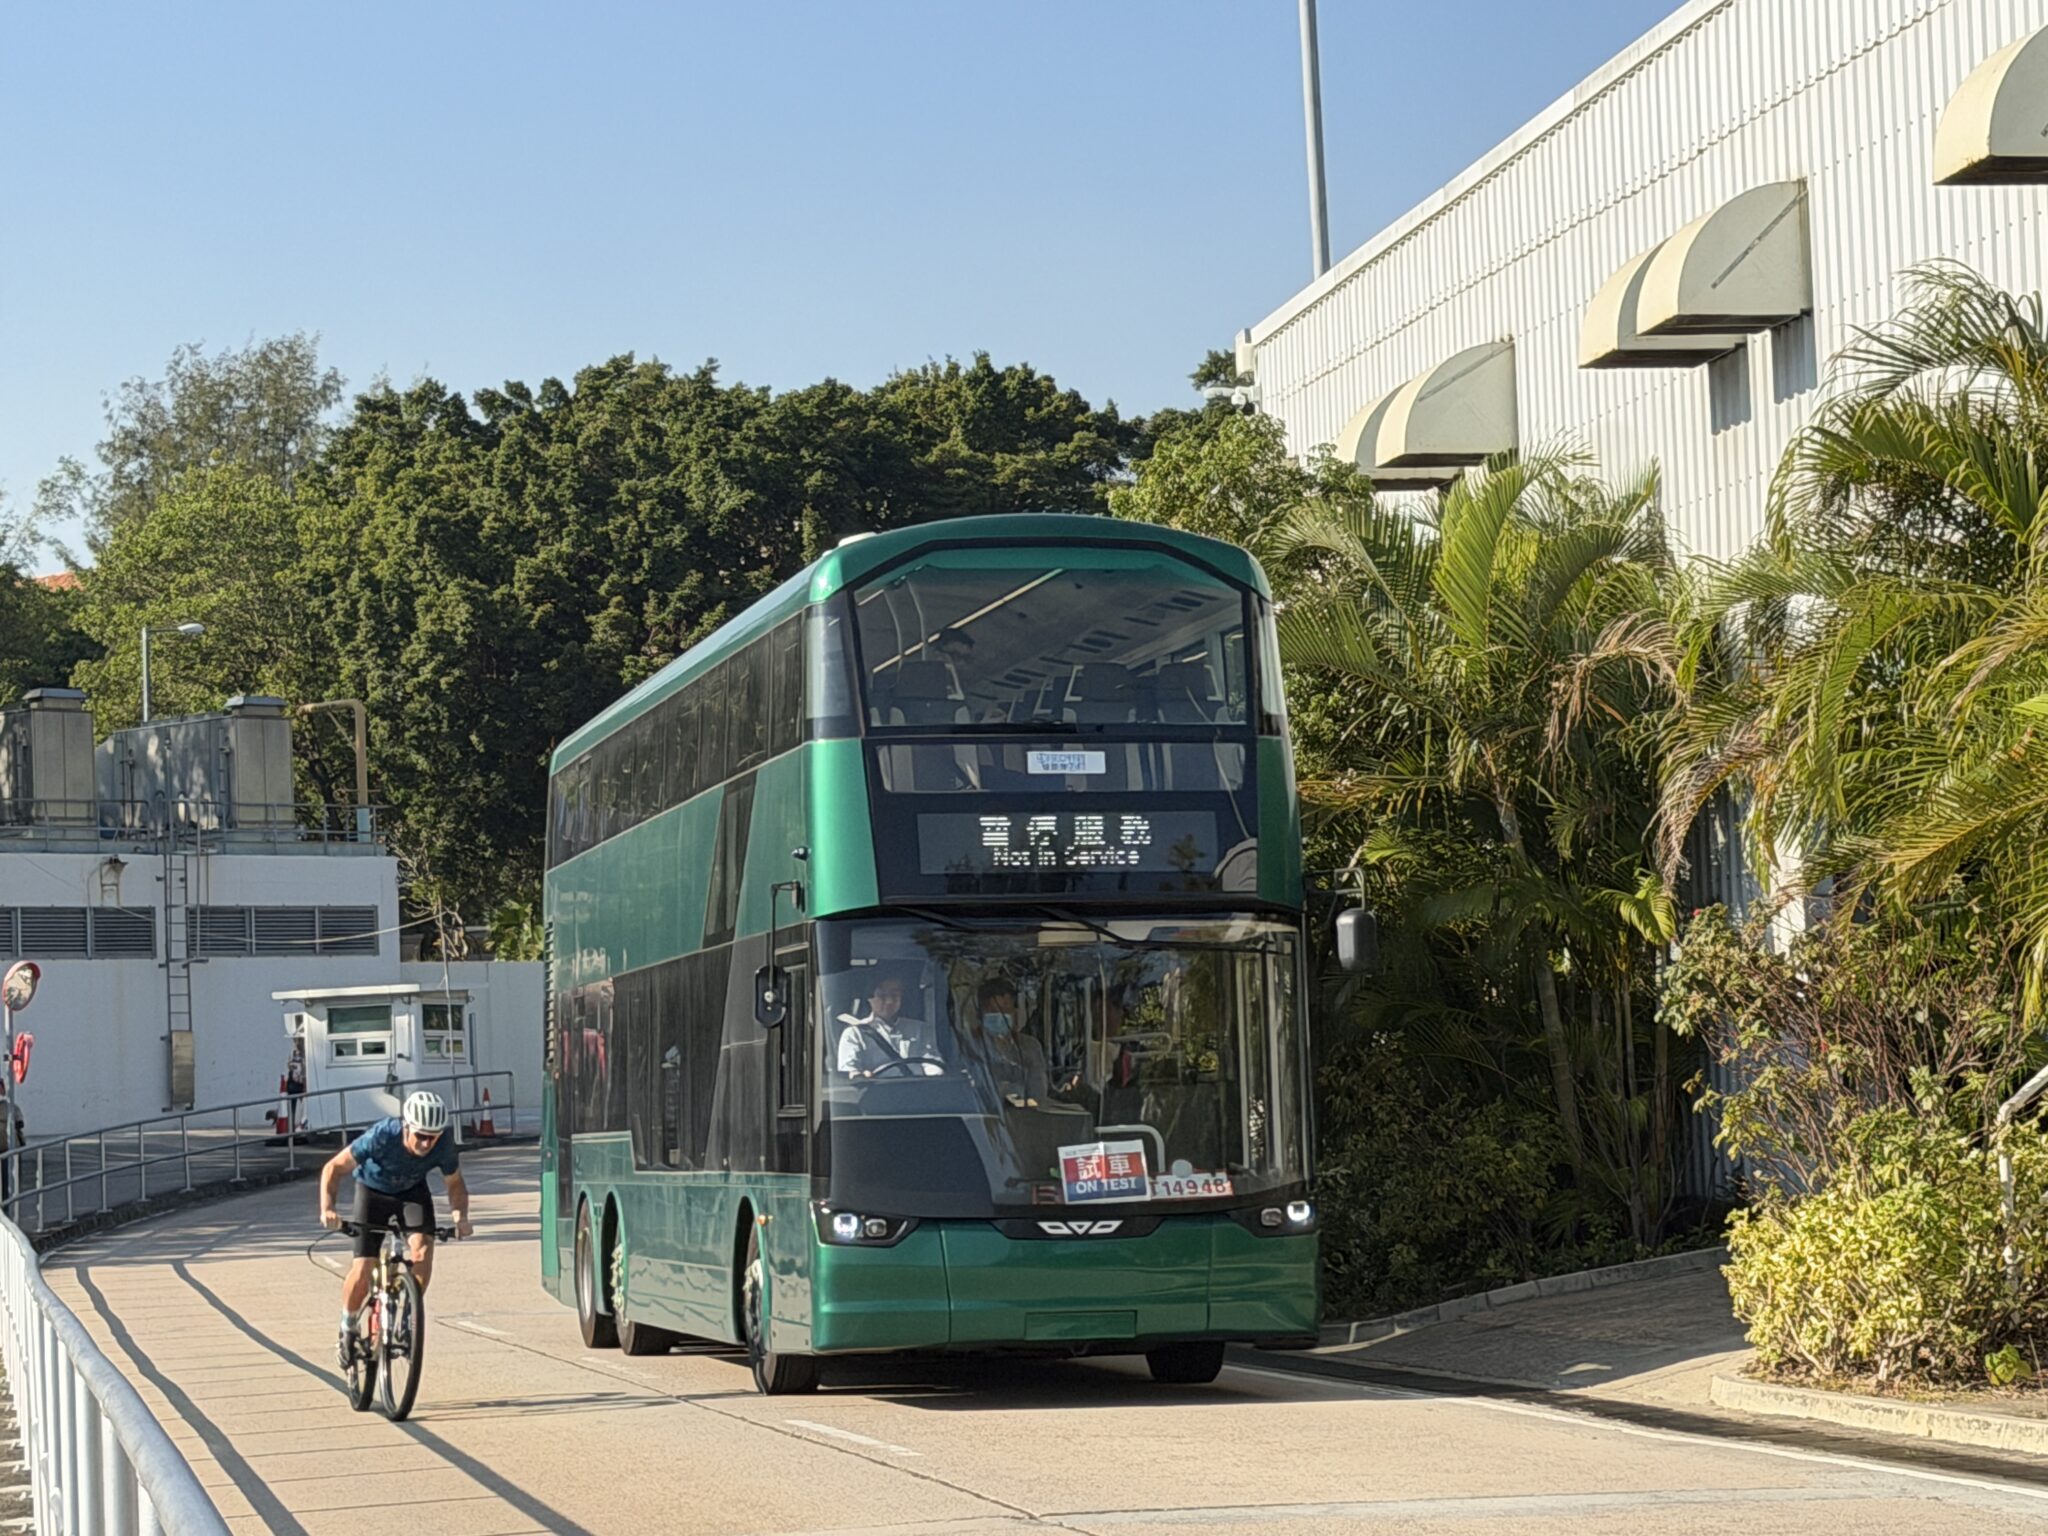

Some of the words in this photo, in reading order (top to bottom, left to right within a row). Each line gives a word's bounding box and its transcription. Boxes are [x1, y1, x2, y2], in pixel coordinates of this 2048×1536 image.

[993, 847, 1031, 866] Not
[1064, 846, 1140, 866] Service
[1076, 1155, 1132, 1180] 試車
[1076, 1180, 1098, 1194] ON
[1101, 1177, 1137, 1192] TEST
